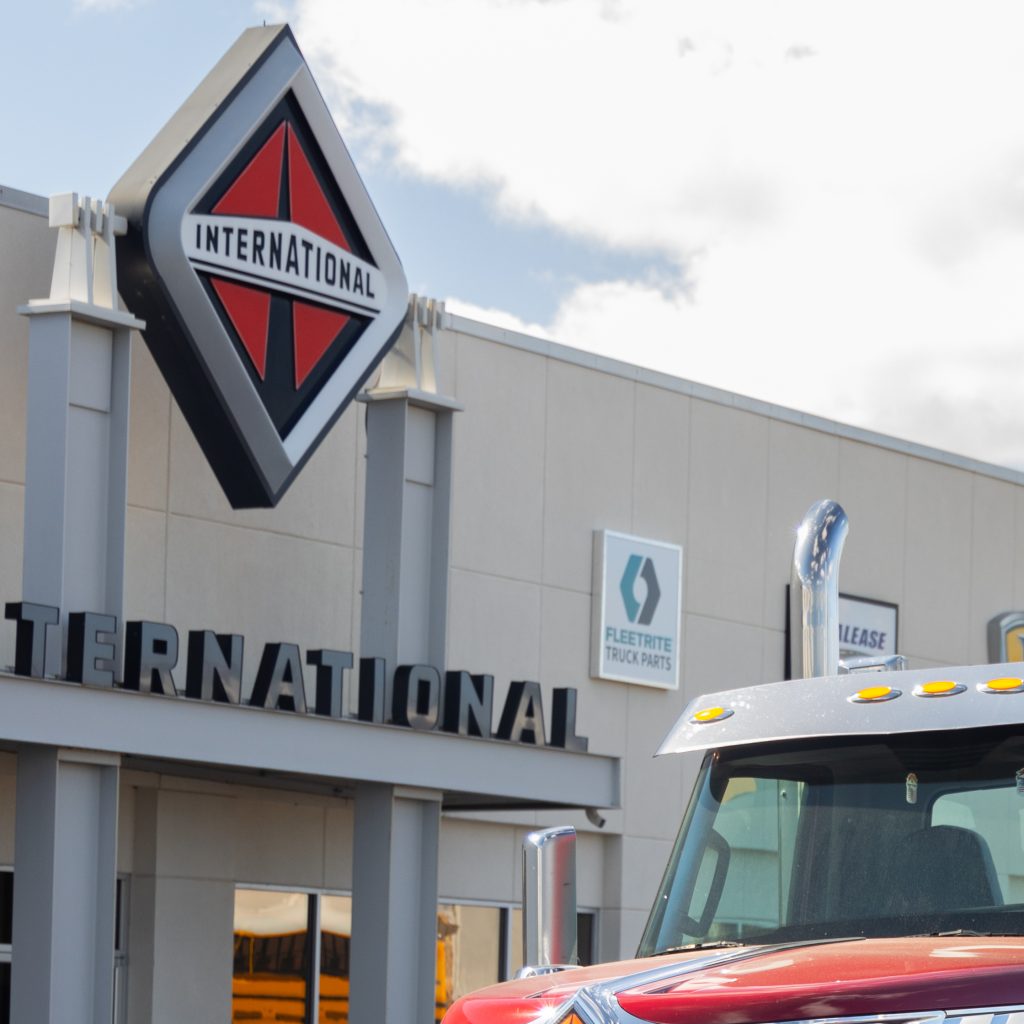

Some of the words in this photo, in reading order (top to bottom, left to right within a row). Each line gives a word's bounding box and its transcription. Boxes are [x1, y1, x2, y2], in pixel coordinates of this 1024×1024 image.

[196, 224, 375, 299] INTERNATIONAL
[605, 626, 673, 653] FLEETRITE
[605, 646, 639, 666] TRUCK
[641, 652, 672, 671] PARTS
